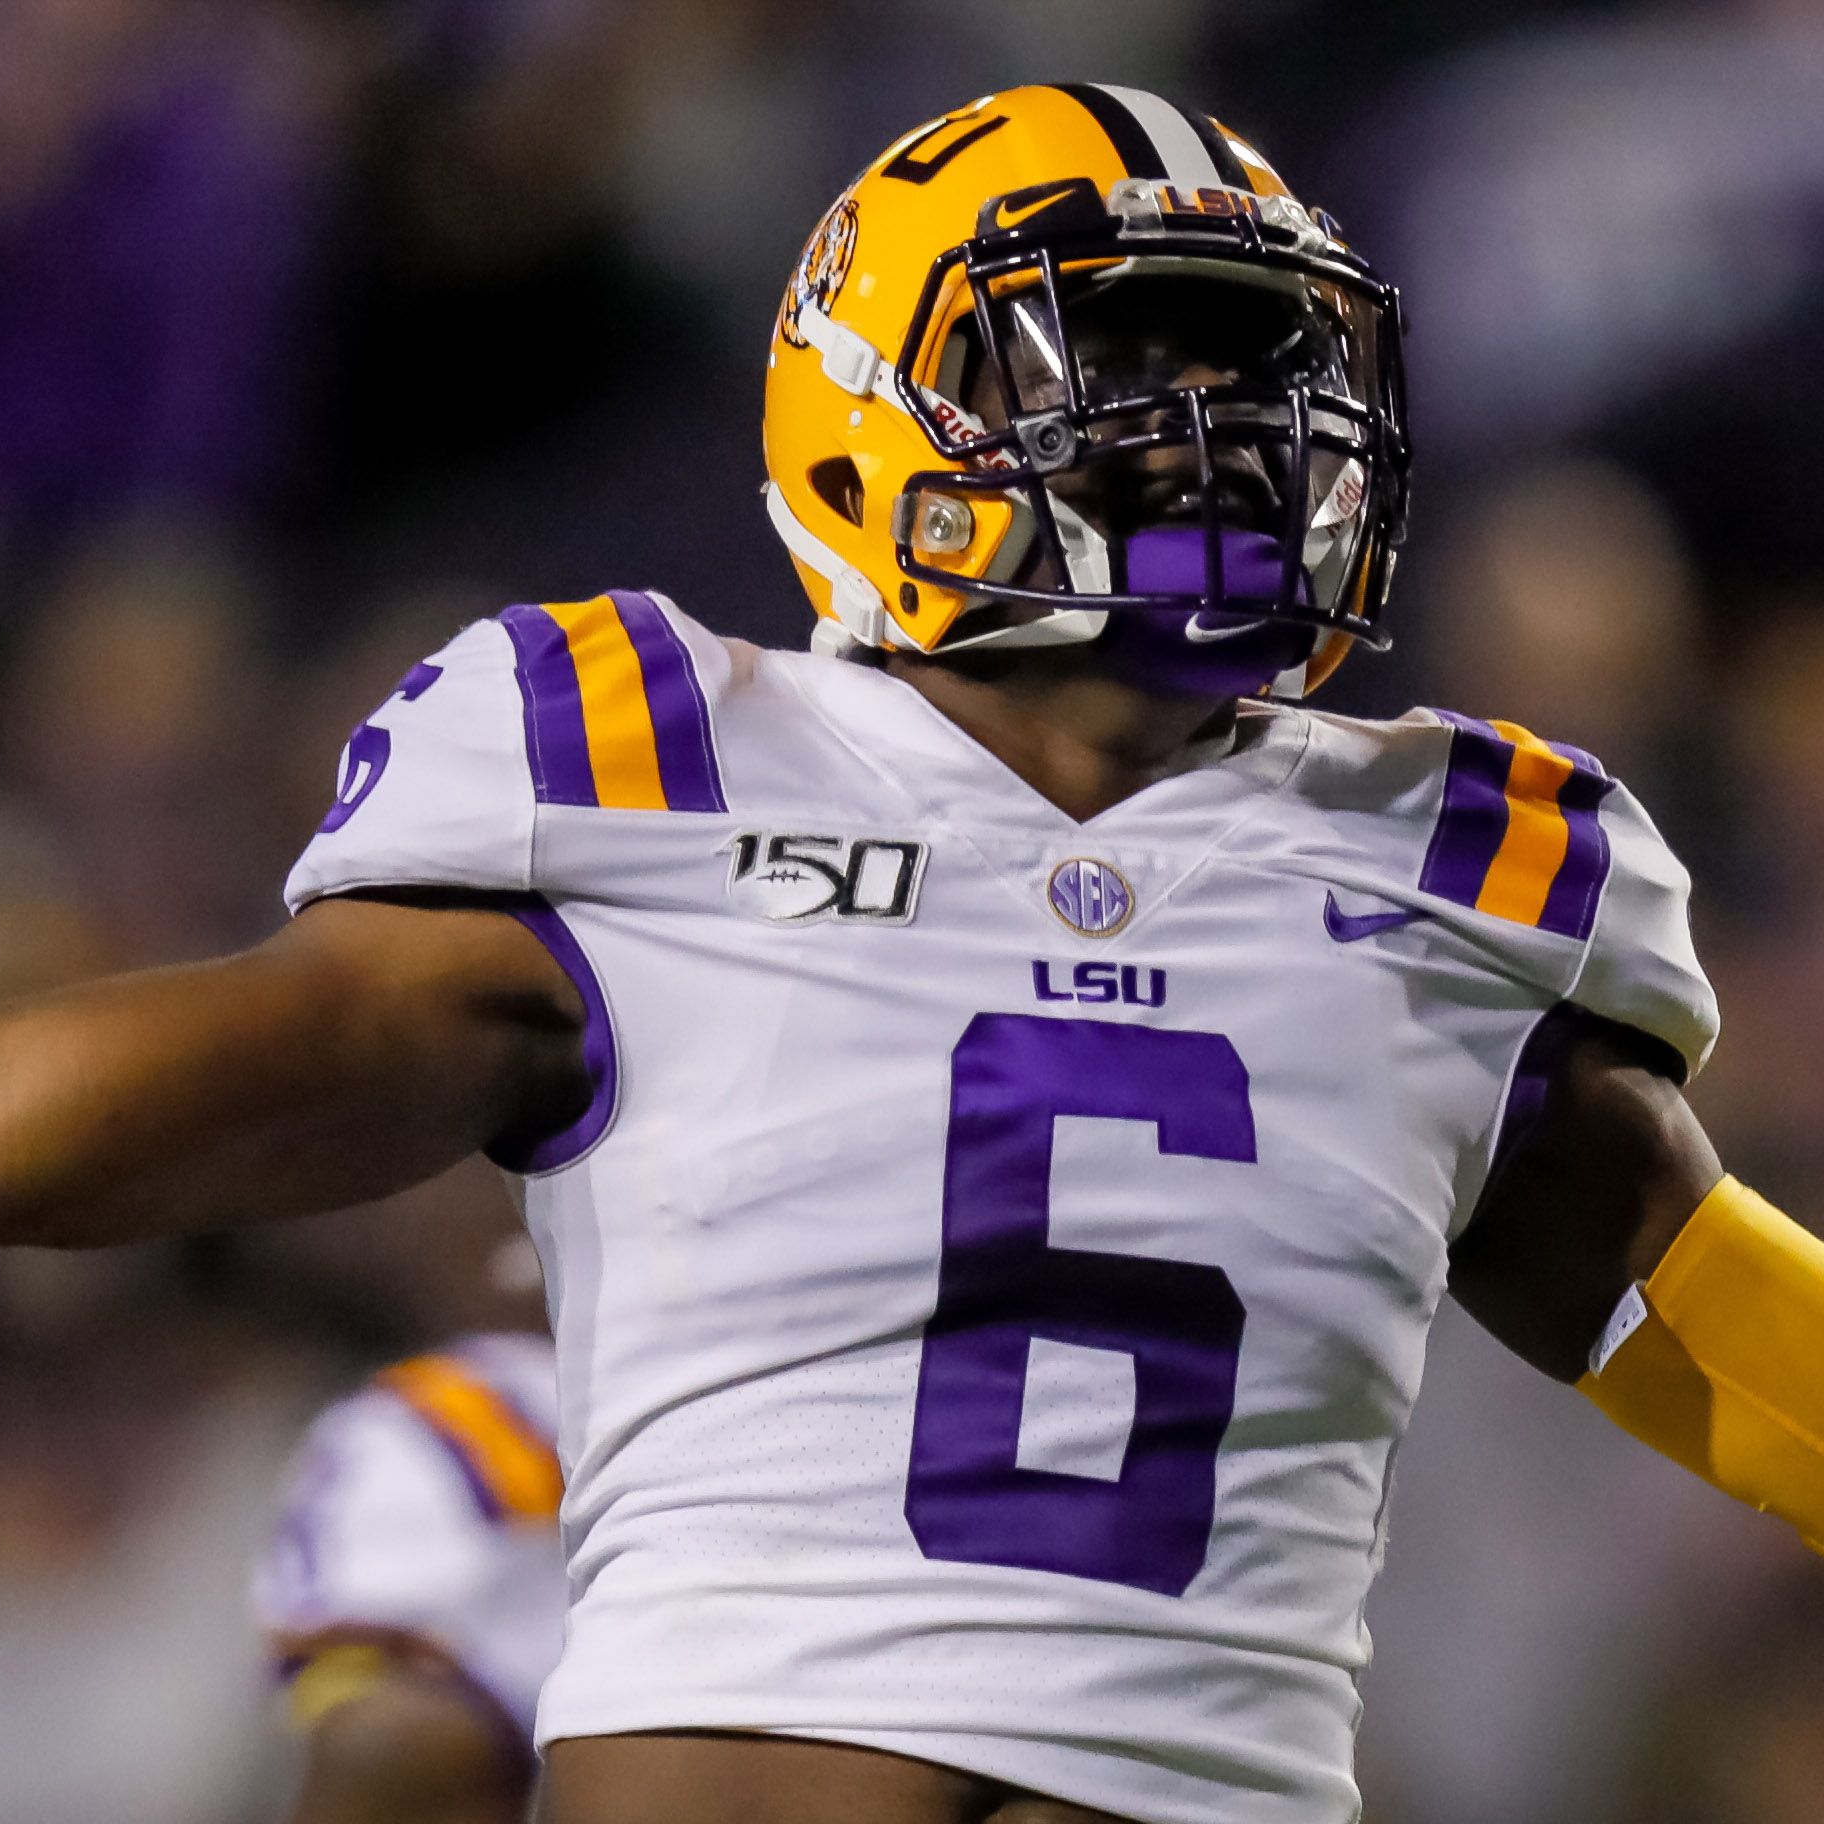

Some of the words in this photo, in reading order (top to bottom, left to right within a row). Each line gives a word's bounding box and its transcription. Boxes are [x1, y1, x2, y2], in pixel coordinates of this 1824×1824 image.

[732, 832, 934, 926] 150
[1049, 858, 1133, 937] SEC
[1032, 959, 1167, 1008] LSU
[904, 1011, 1258, 1599] 6
